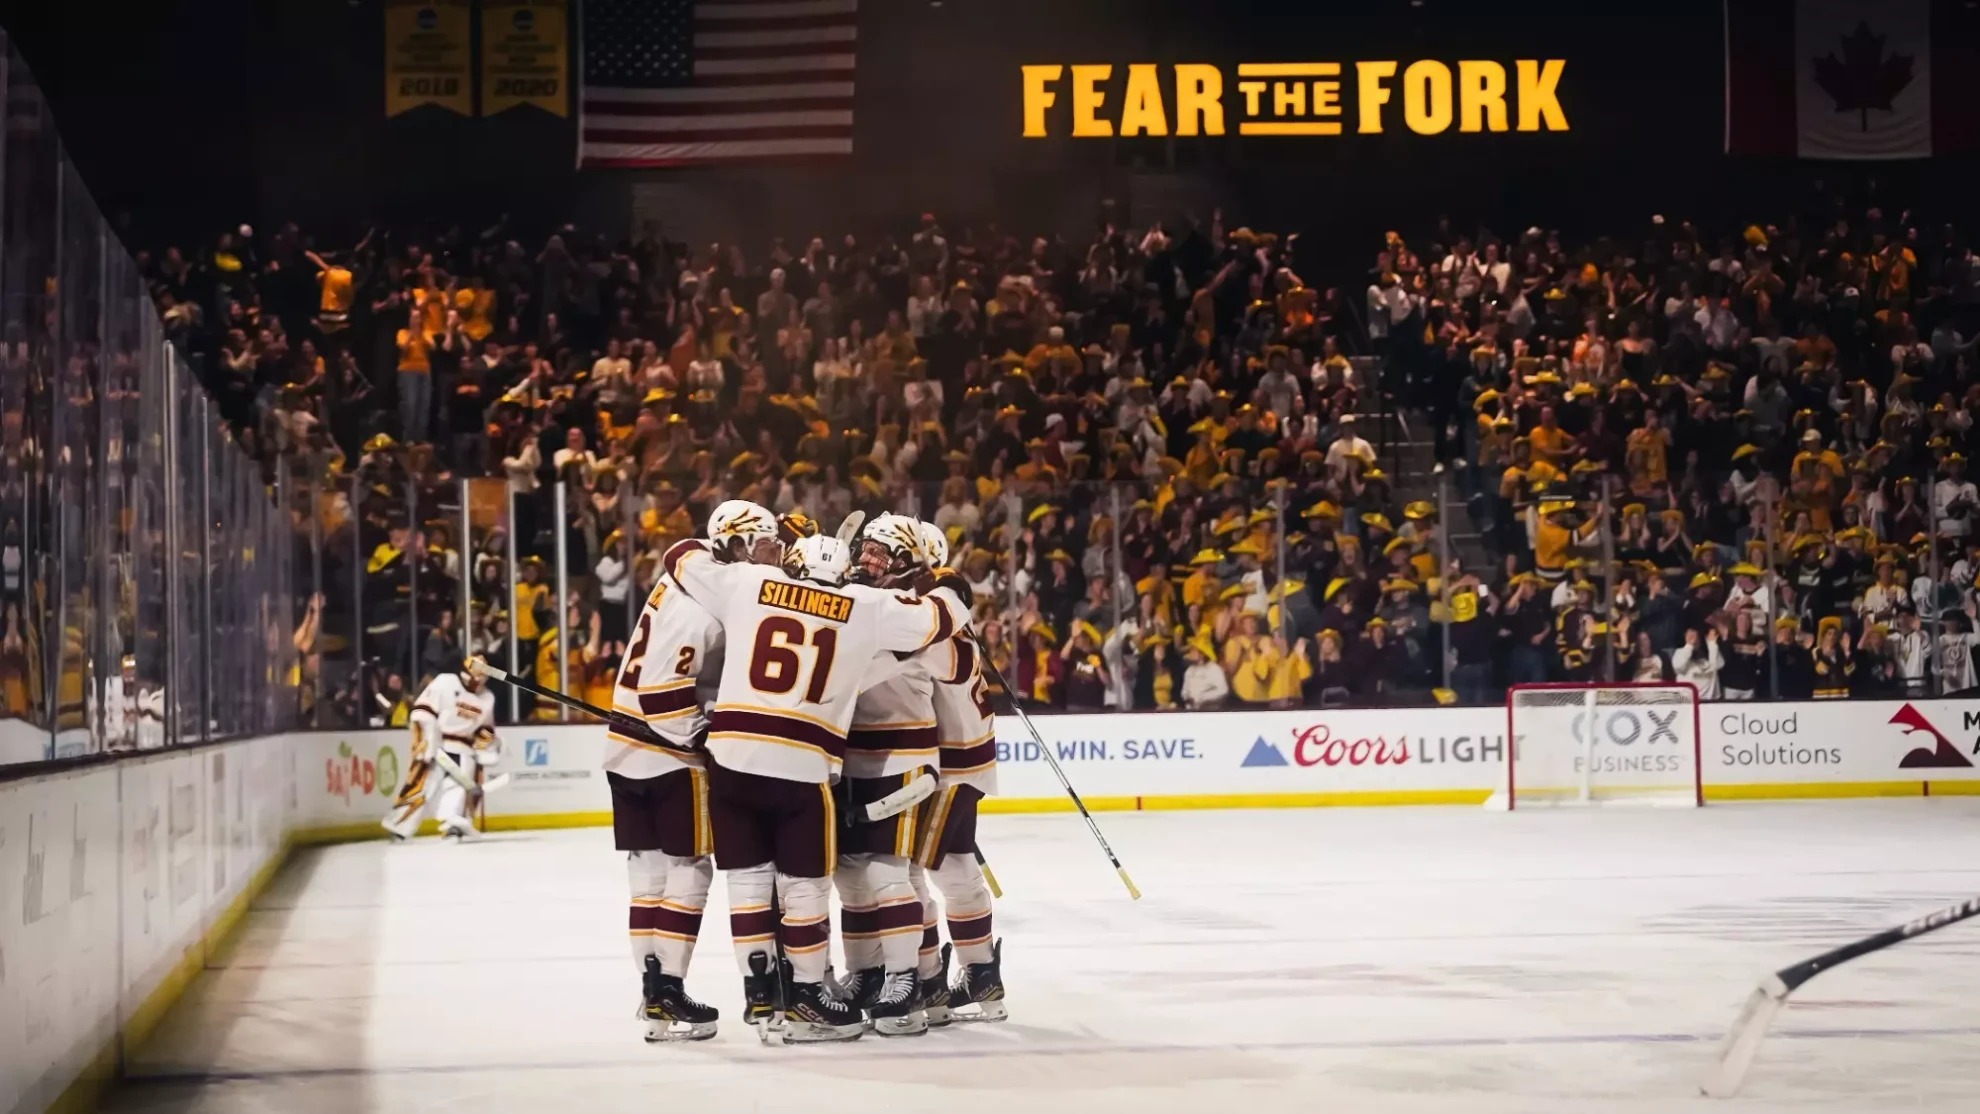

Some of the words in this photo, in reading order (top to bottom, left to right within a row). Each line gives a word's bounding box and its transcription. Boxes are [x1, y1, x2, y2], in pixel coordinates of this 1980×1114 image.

[494, 78, 559, 96] 2020
[1020, 63, 1226, 138] FEAR
[1238, 81, 1342, 116] THE
[1355, 59, 1570, 135] FORK
[821, 553, 833, 563] 61
[760, 581, 852, 621] SILLINGER
[675, 646, 695, 675] 2
[749, 615, 837, 704] 61
[1572, 710, 1679, 746] COX
[1720, 711, 1798, 735] Cloud
[995, 742, 1047, 762] BID.
[1057, 741, 1115, 760] WIN.
[1123, 739, 1204, 760] SAVE.
[1291, 724, 1411, 767] Coors
[1419, 735, 1527, 764] LIGHT
[1722, 742, 1843, 766] Solutions
